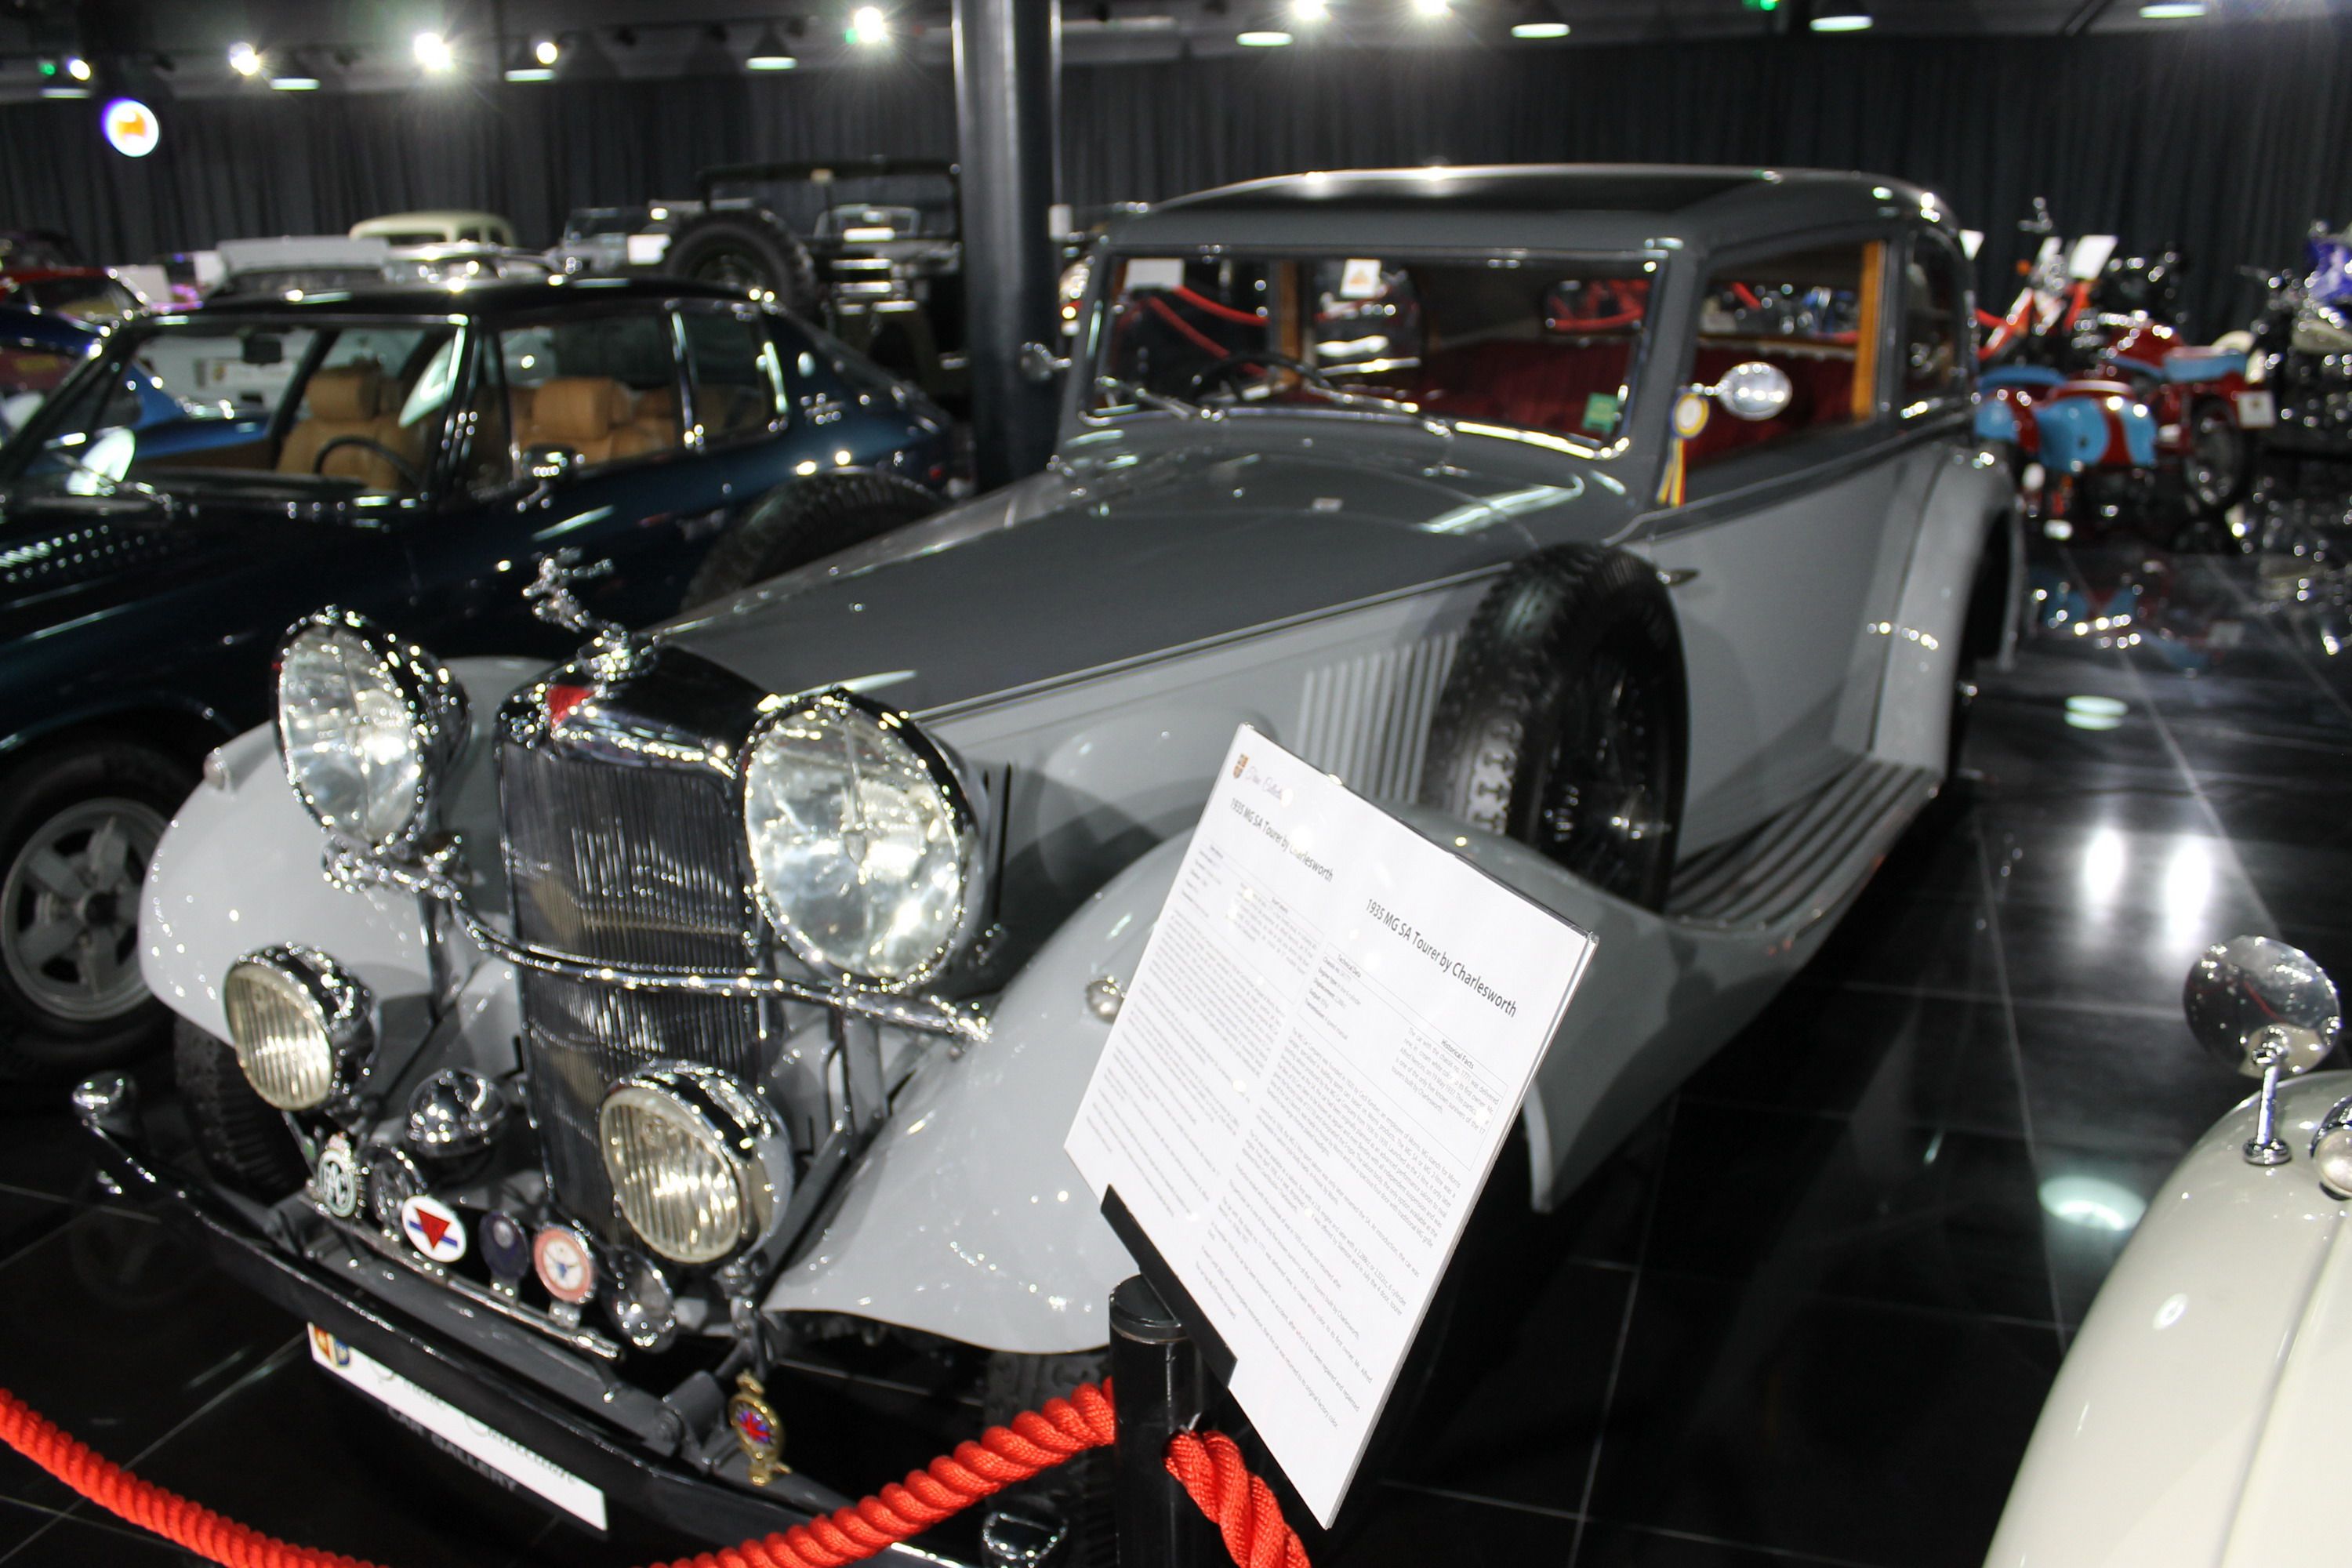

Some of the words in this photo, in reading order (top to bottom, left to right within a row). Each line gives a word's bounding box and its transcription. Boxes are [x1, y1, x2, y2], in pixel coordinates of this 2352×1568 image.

[1230, 797, 1245, 815] 1935
[1243, 808, 1256, 824] MG
[1253, 816, 1265, 829] SA
[1261, 821, 1284, 844] Tourer
[1282, 834, 1292, 852] by
[1290, 843, 1334, 882] arlesworth
[1337, 954, 1353, 971] Technical
[1352, 967, 1361, 978] Data
[1366, 898, 1384, 920] 1935
[1383, 911, 1401, 932] MG
[1398, 923, 1412, 941] SA
[1412, 931, 1442, 961] Tourer
[1439, 951, 1452, 973] by
[1452, 962, 1518, 1018] Charlesworth
[1441, 1038, 1463, 1060] Historical
[1461, 1055, 1474, 1069] Facts
[430, 1432, 518, 1492] GALLERY
